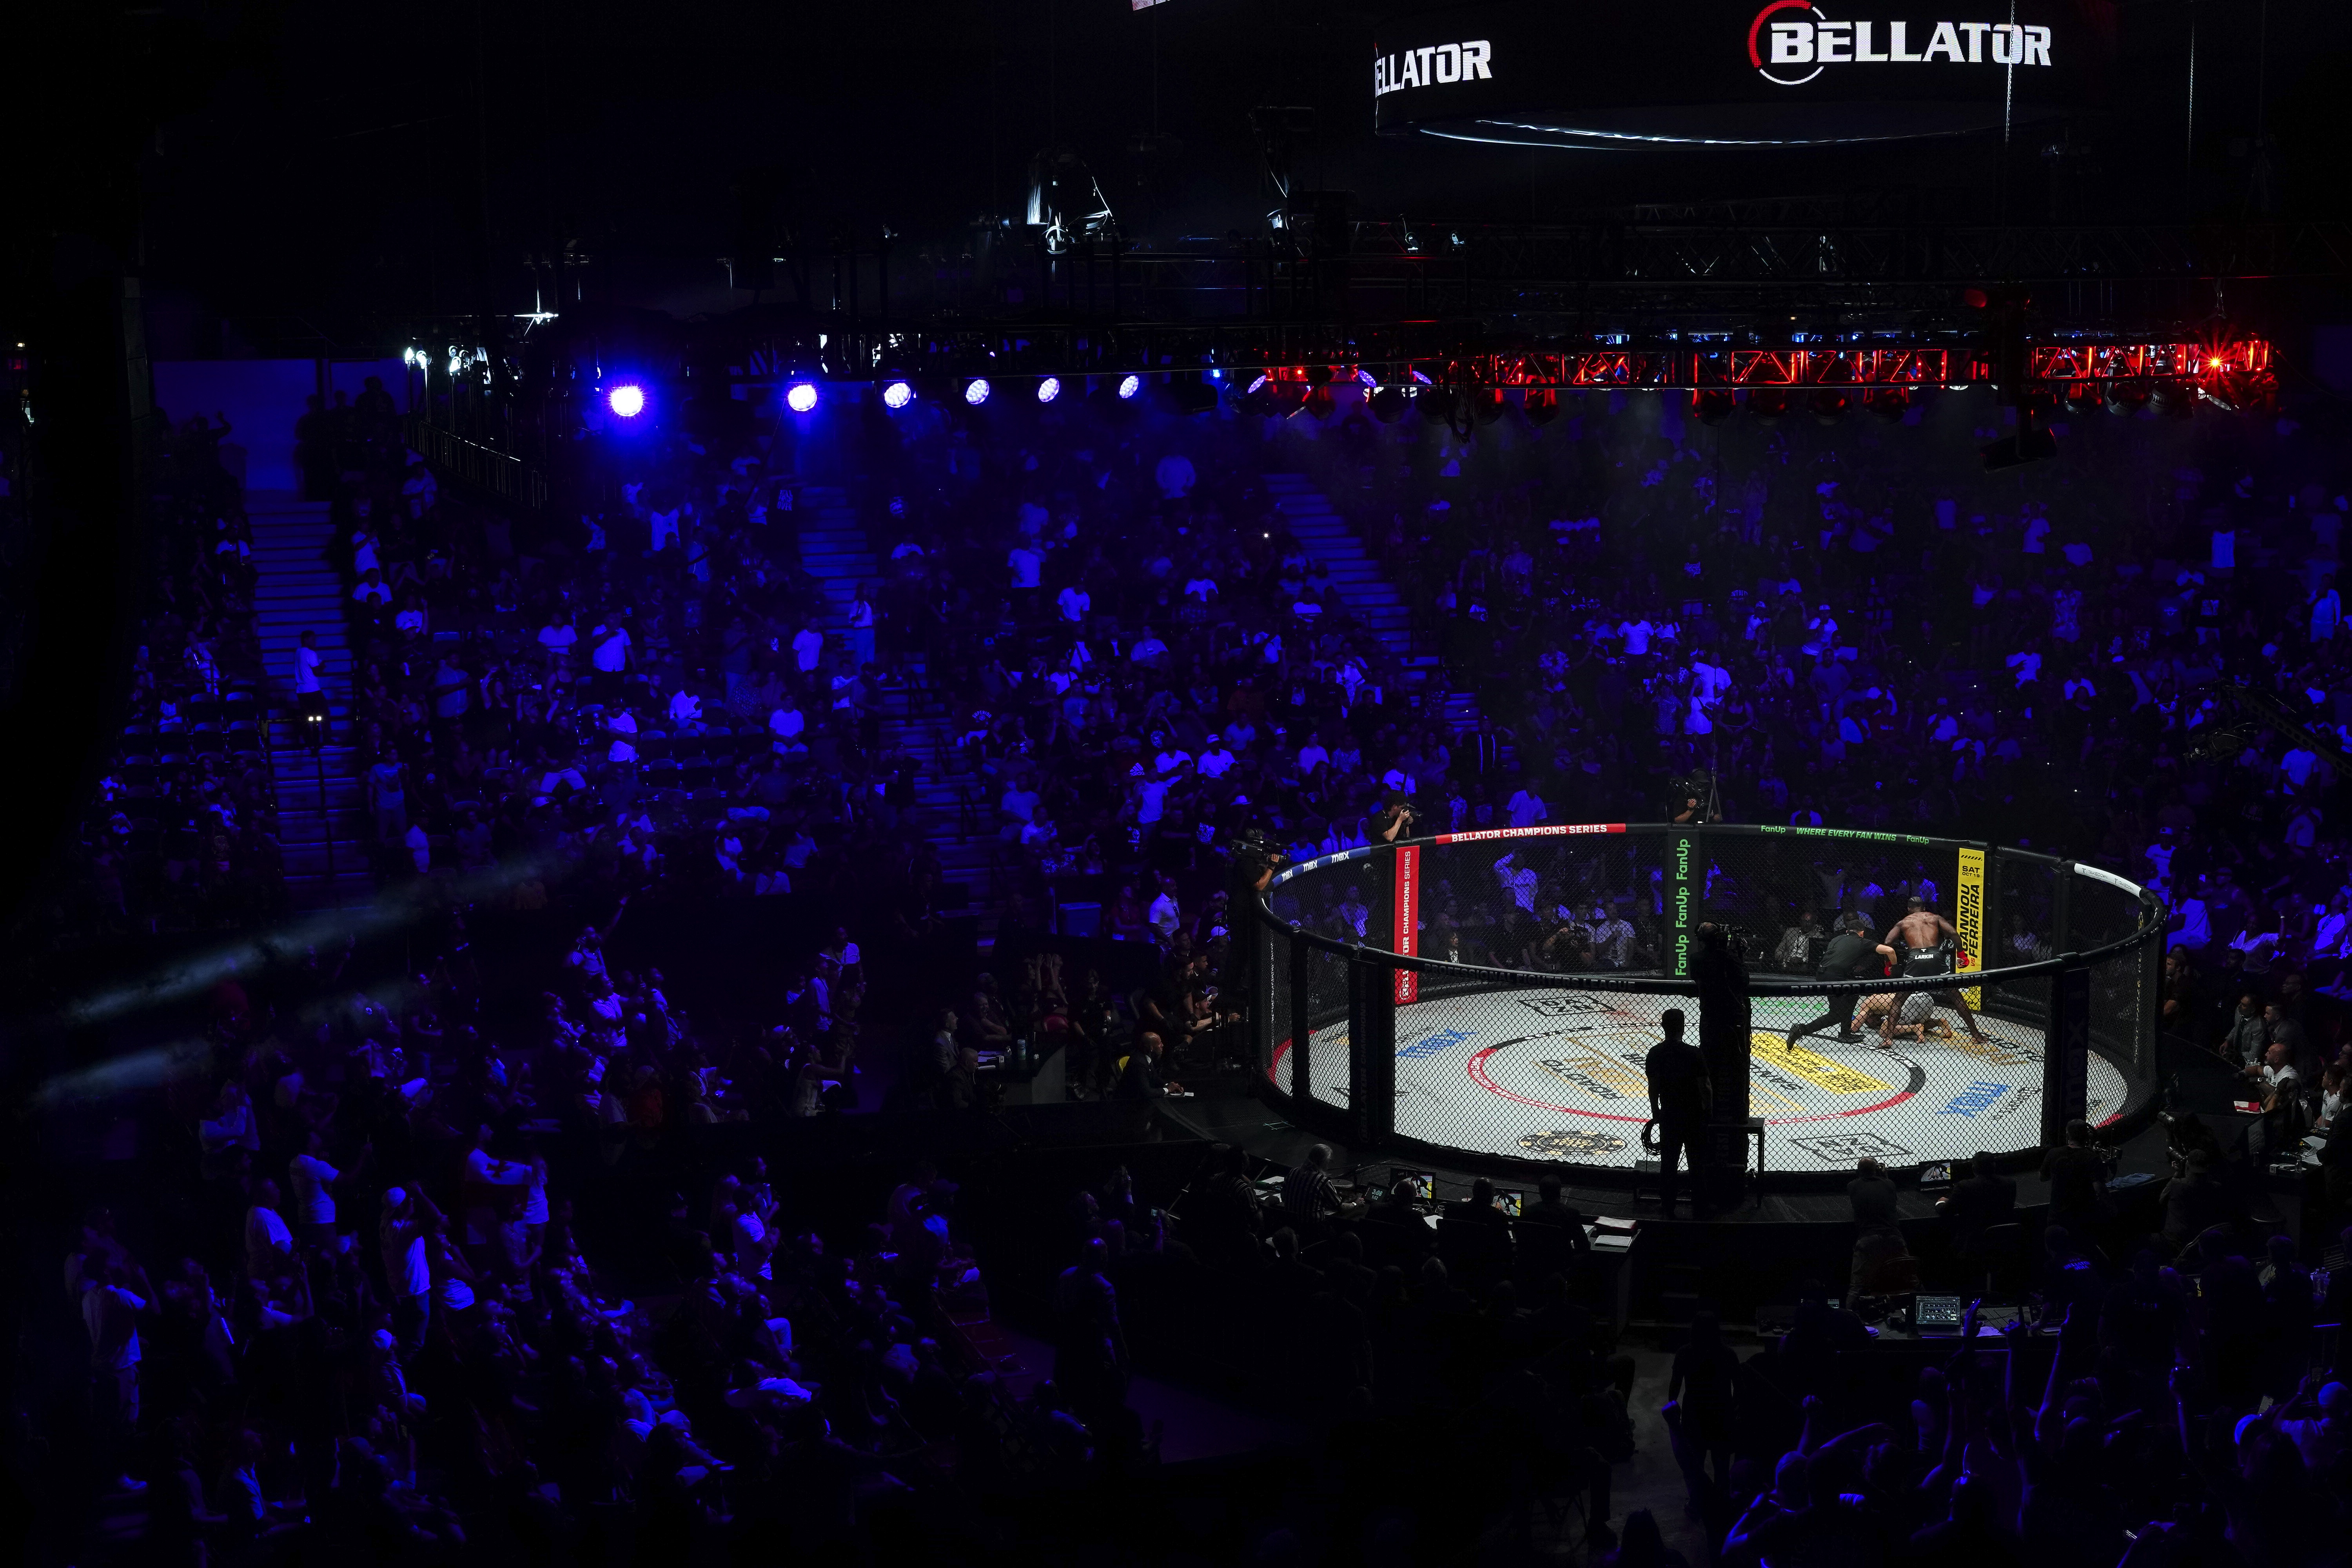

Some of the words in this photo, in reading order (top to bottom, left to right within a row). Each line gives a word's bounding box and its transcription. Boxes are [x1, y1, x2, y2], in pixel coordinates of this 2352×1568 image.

[1771, 21, 2052, 66] BELLATOR
[1451, 829, 1501, 842] BELLATOR
[1503, 826, 1567, 838] CHAMPIONS
[1569, 824, 1607, 834] SERIES
[1761, 825, 1786, 834] FanUp
[1796, 828, 1826, 836] WHERE
[1828, 829, 1855, 838] EVERY
[1873, 833, 1896, 841] WINS
[1906, 835, 1929, 844] FanUp
[1303, 860, 1318, 872] max
[1331, 851, 1350, 864] max
[1676, 839, 1691, 880] FanUp
[1281, 869, 1293, 882] max
[1675, 886, 1690, 928] FanUp
[1960, 883, 1970, 957] GANNOU
[1969, 884, 1980, 958] FERREIRA
[1675, 935, 1690, 976] FanUp
[1424, 963, 1512, 982] PROFESSIONAL
[1515, 974, 1579, 988] FIGHTERS
[1583, 978, 1636, 991] LEAGUE
[1790, 984, 1861, 995] BELLATOR
[1865, 978, 1944, 993] CHAMPIONS
[1947, 973, 1989, 987] SERIES
